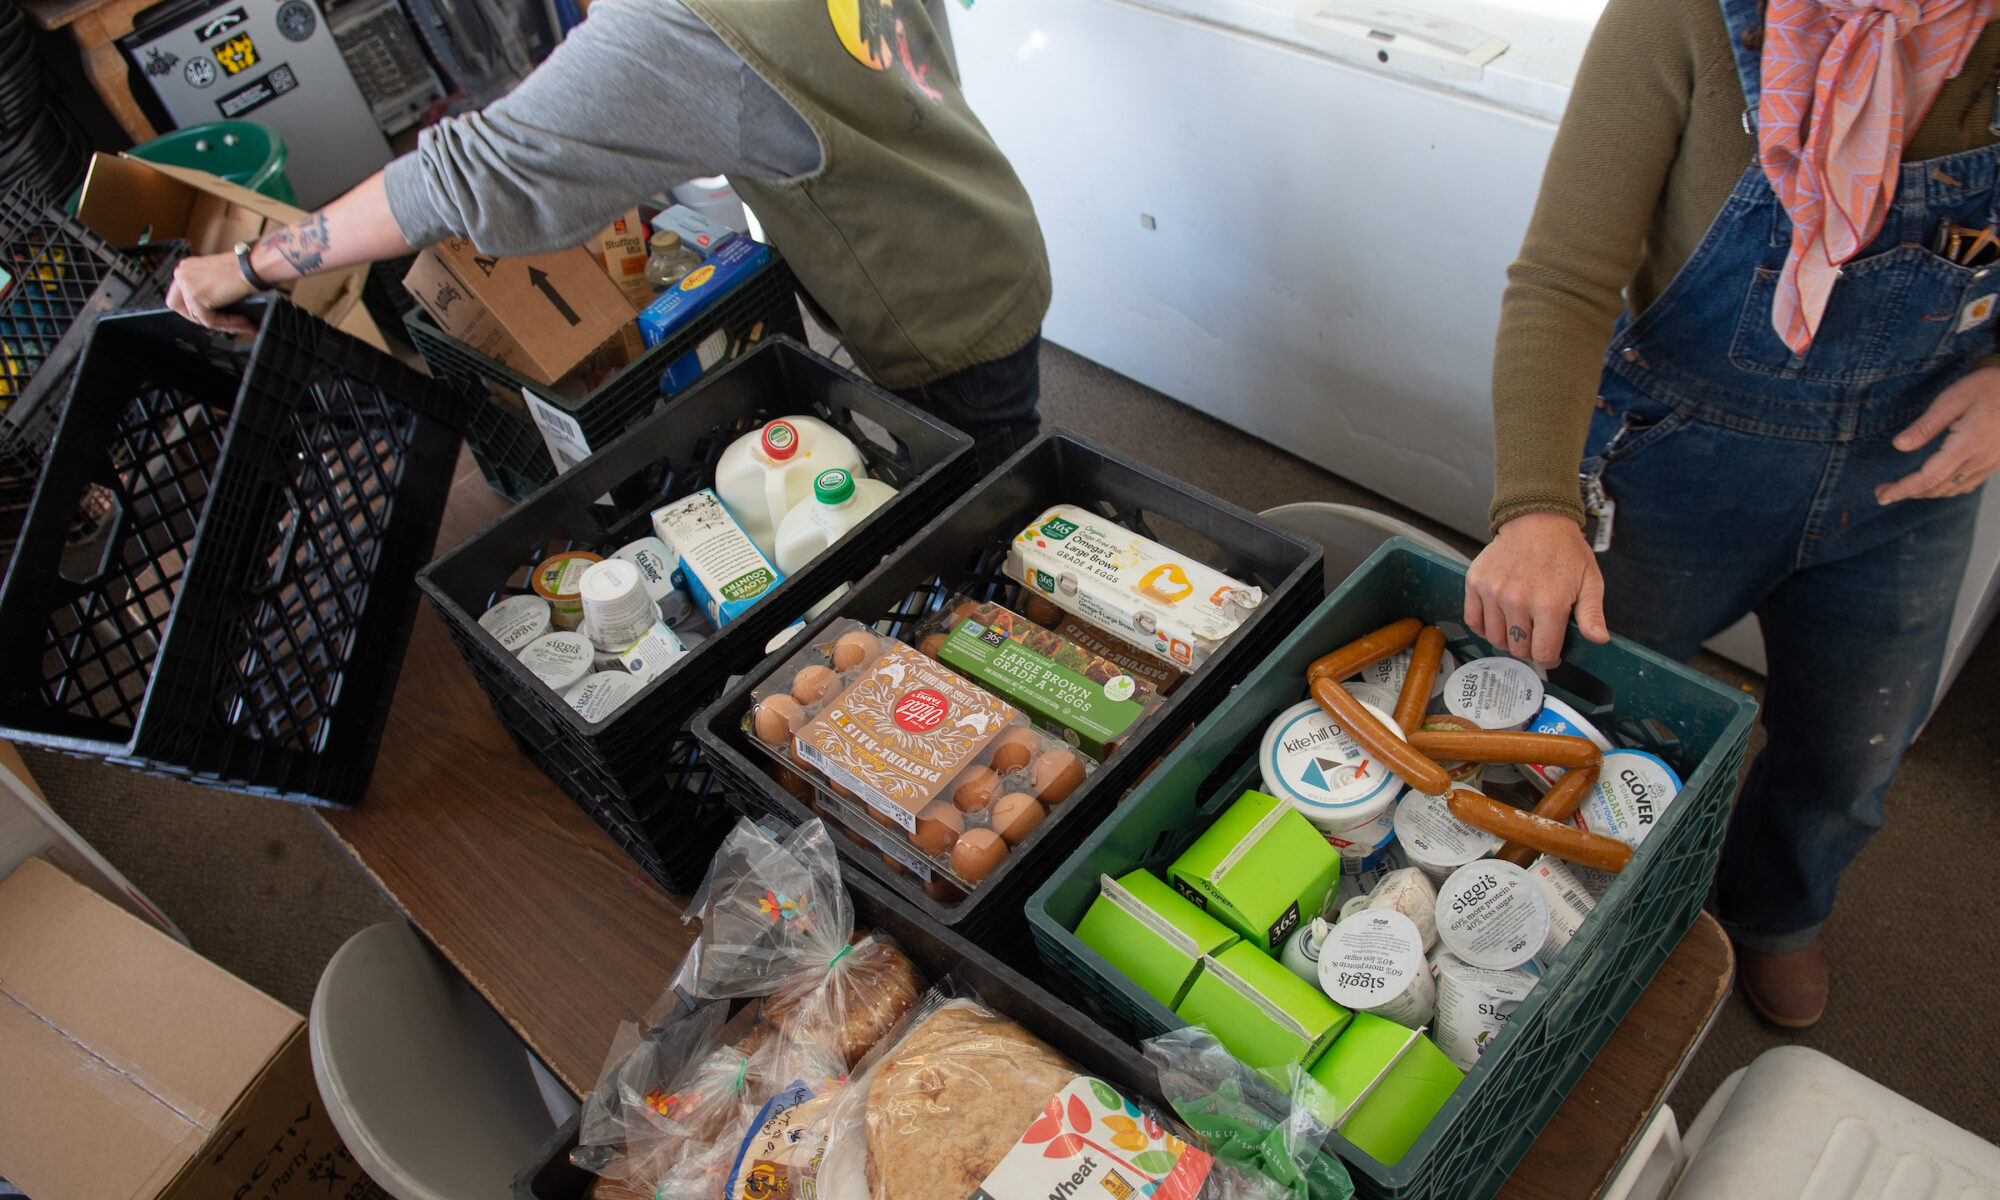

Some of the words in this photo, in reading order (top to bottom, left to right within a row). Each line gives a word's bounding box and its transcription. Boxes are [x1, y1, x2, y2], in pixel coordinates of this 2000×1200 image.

[605, 237, 641, 251] Stuffing
[626, 246, 641, 255] Mix
[1047, 520, 1073, 535] 365
[1078, 530, 1109, 547] Cage-Free
[1084, 525, 1106, 538] Organic
[1063, 541, 1089, 557] Large
[1089, 553, 1118, 572] Brown
[1071, 535, 1114, 558] Omega-3
[1056, 550, 1085, 566] GRADE
[1094, 568, 1119, 583] EGGS
[724, 569, 766, 594] COUNTRY
[730, 574, 768, 597] CLOVER
[1035, 573, 1056, 587] 365
[984, 631, 1002, 643] 365
[1006, 643, 1056, 668] pasture-raised
[1065, 624, 1168, 680] PASTURE-RAISED
[992, 657, 1036, 683] GRADE
[1034, 679, 1047, 689] A
[1055, 688, 1091, 711] EGGS
[999, 648, 1042, 674] LARGE
[1041, 669, 1092, 699] BROWN
[1372, 661, 1394, 683] sigg
[1457, 672, 1478, 708] siggi's
[895, 699, 943, 734] Vital
[829, 709, 941, 783] PASTURE-RAISD
[1283, 736, 1311, 753] kite
[1308, 727, 1329, 743] hill
[852, 745, 889, 771] Organic
[1599, 780, 1627, 827] ORGANIC
[1618, 783, 1636, 816] SONOMA
[1620, 769, 1653, 825] CLOVER
[1590, 802, 1601, 820] PLAIN
[1602, 805, 1619, 835] YOGURT
[1452, 822, 1469, 836] sugar
[1201, 880, 1210, 890] TO
[1210, 890, 1233, 907] OPEN
[1452, 873, 1497, 914] siggi's
[1450, 918, 1468, 930] 60%
[1466, 904, 1485, 920] more
[1483, 886, 1510, 908] protein
[1466, 918, 1483, 930] 40%
[1480, 908, 1496, 920] less
[1494, 894, 1513, 910] sugar
[1272, 908, 1296, 940] 365
[1338, 960, 1364, 969] protein
[1363, 955, 1375, 963] less
[1364, 963, 1384, 971] more
[1378, 957, 1394, 965] 40%
[1385, 967, 1403, 976] 60%
[1337, 971, 1384, 993] siggi's
[271, 1147, 308, 1194] Party
[1048, 1155, 1098, 1200] Wheat
